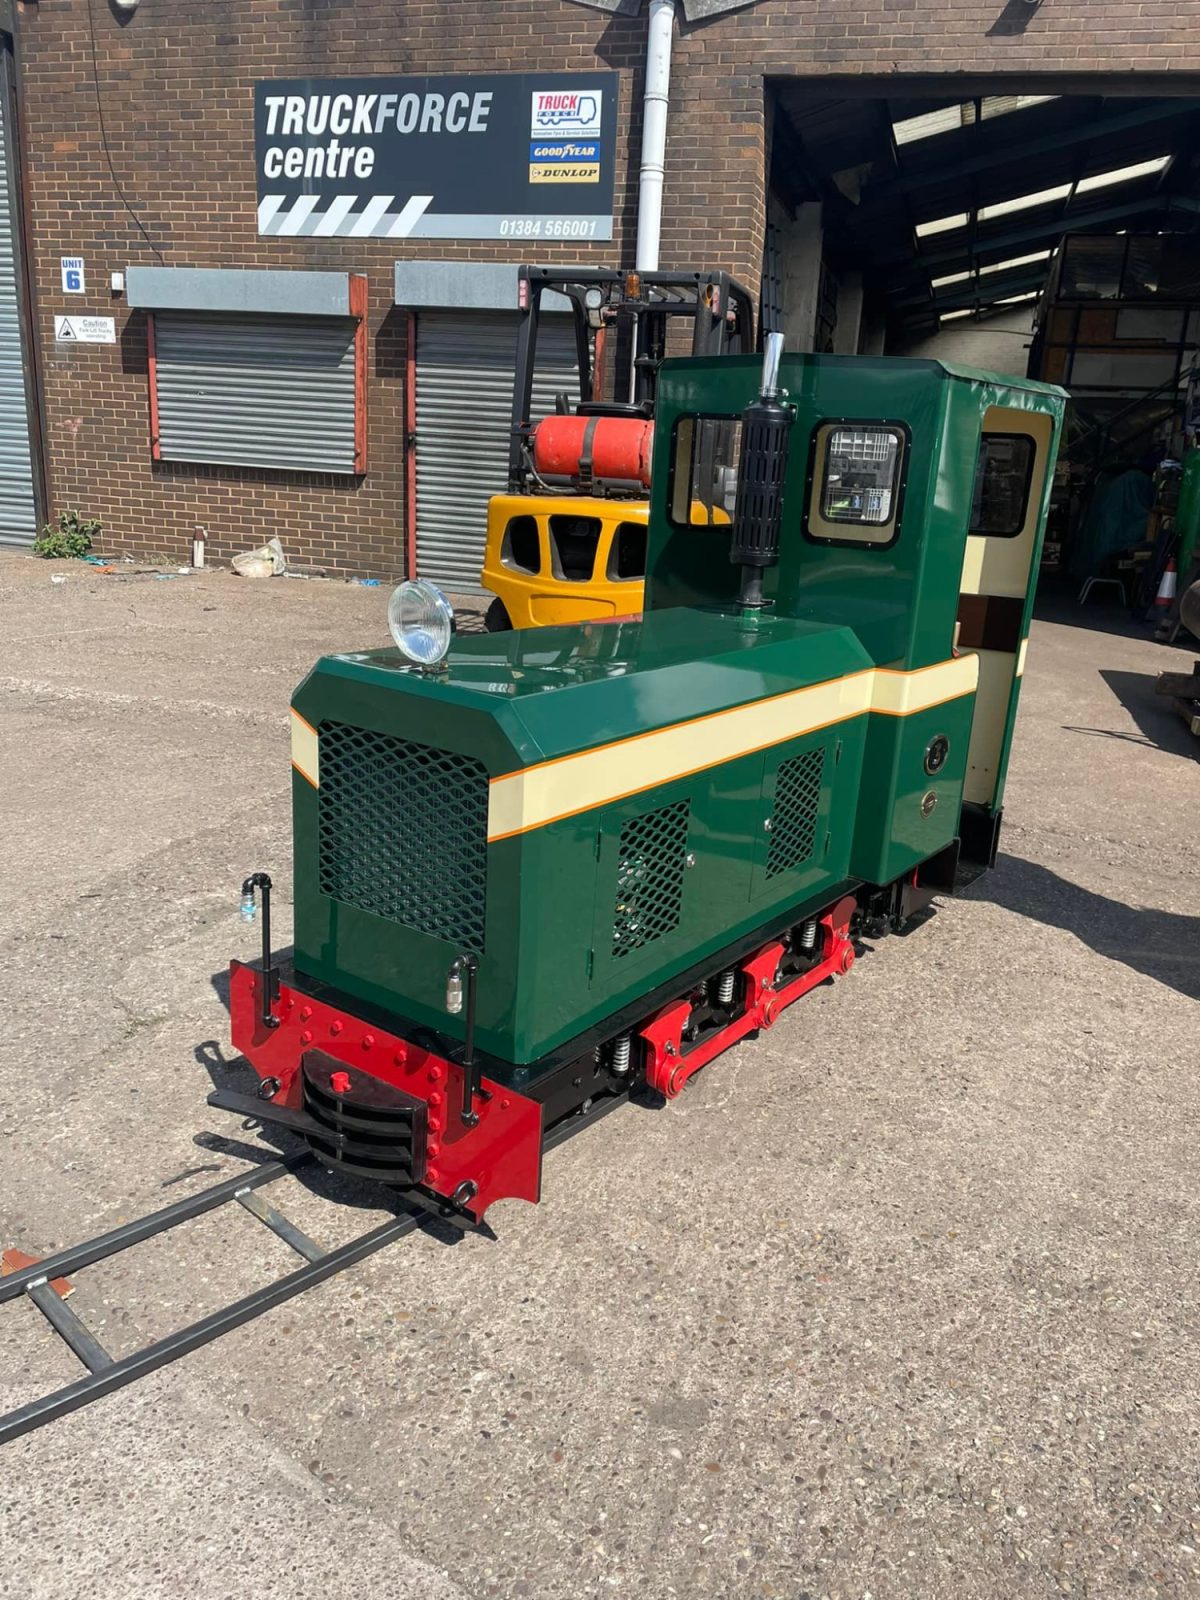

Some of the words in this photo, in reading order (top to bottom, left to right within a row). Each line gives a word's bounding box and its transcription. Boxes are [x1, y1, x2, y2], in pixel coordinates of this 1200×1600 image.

[538, 95, 578, 110] TRUCK
[264, 92, 493, 135] TRUCKFORCE
[534, 144, 595, 158] GOODYEAR
[264, 139, 375, 179] centre
[542, 169, 597, 177] DUNLOP
[499, 220, 541, 235] 01384
[545, 220, 596, 236] 566001
[62, 259, 82, 268] UNIT
[66, 270, 80, 290] 6
[82, 319, 107, 328] Caution
